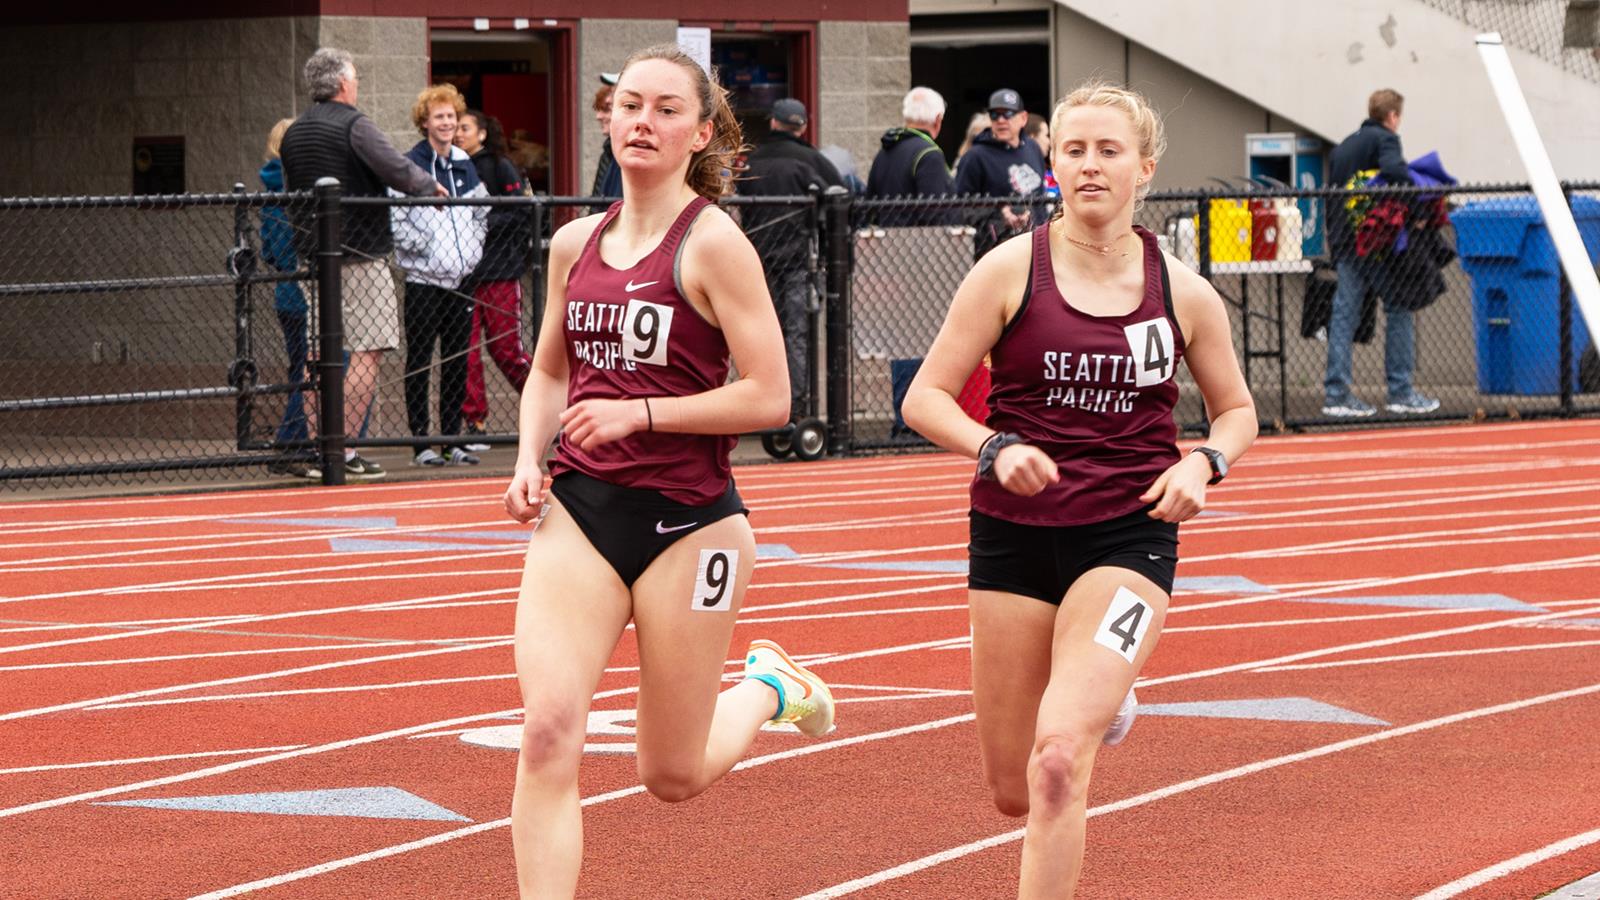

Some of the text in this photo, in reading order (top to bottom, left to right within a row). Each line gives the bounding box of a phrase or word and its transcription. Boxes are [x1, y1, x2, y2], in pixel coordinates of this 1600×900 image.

[567, 301, 625, 334] SEATTL
[633, 305, 660, 359] 9
[1043, 351, 1136, 383] SEATTL
[1144, 324, 1169, 379] 4
[1046, 387, 1140, 413] PACIFIC
[702, 552, 729, 607] 9
[1108, 602, 1146, 653] 4
